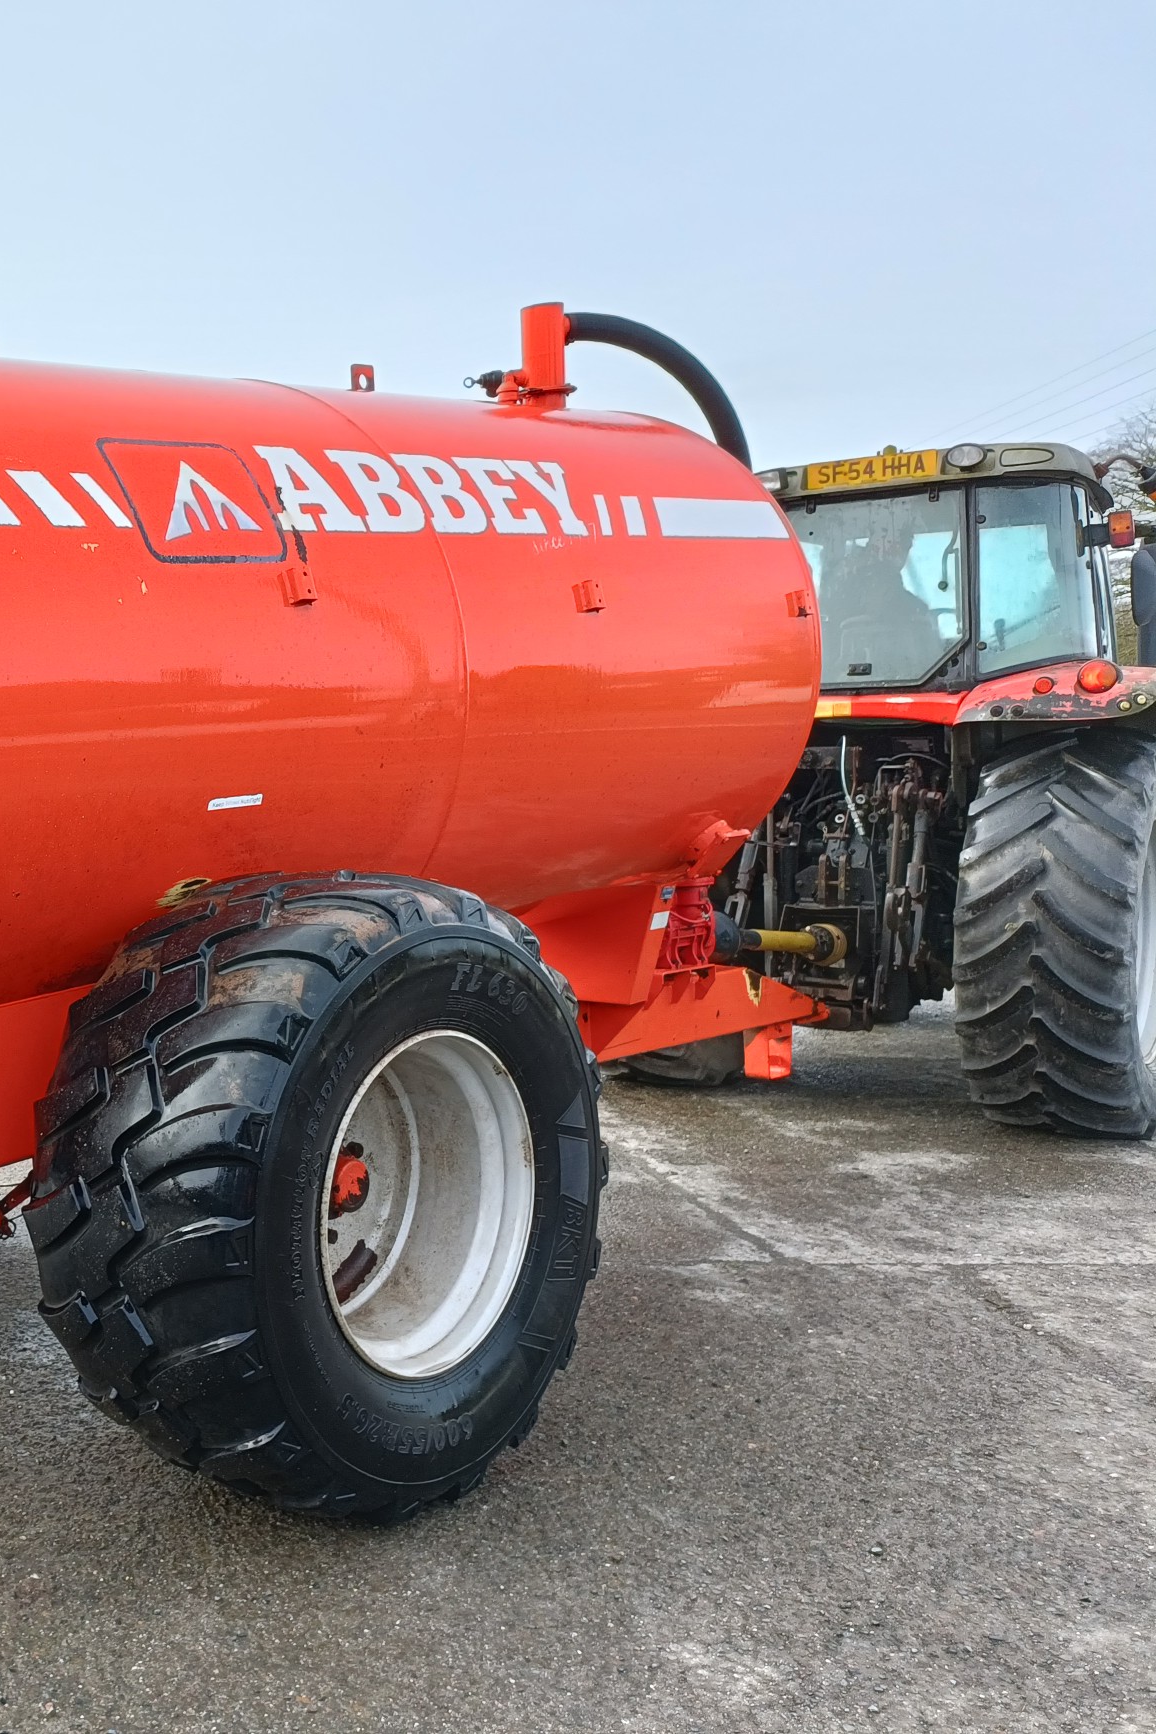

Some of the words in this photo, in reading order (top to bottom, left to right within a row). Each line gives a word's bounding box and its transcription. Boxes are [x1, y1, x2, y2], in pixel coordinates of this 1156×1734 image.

[252, 445, 589, 536] ABBEY
[818, 460, 875, 485] SF54
[882, 454, 926, 477] HHA
[487, 972, 529, 1015] 630
[306, 1041, 355, 1140] RADIAL
[555, 1206, 584, 1276] BKT
